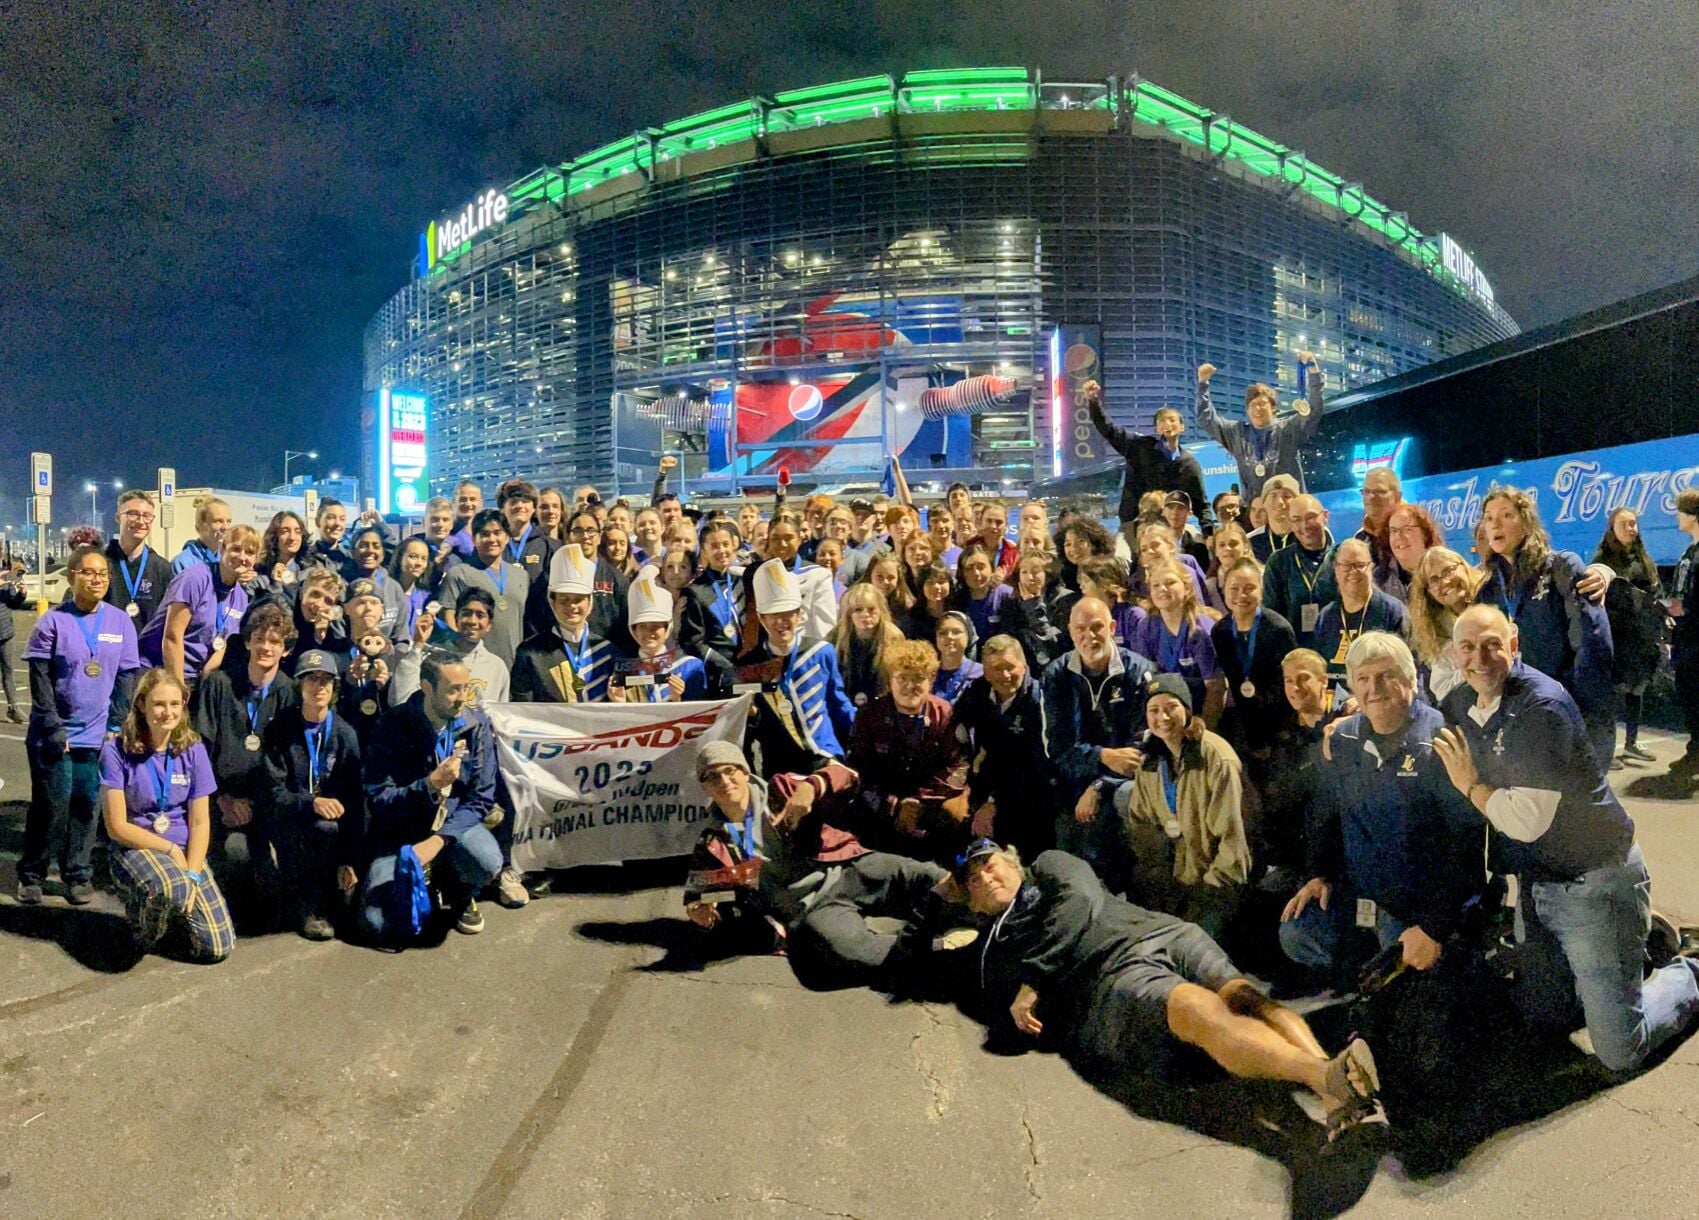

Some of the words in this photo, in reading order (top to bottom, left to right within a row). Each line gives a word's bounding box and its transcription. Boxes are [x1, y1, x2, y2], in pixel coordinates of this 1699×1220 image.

[438, 188, 508, 258] MetLife
[1070, 386, 1096, 459] pepsi
[1553, 460, 1696, 523] Tours
